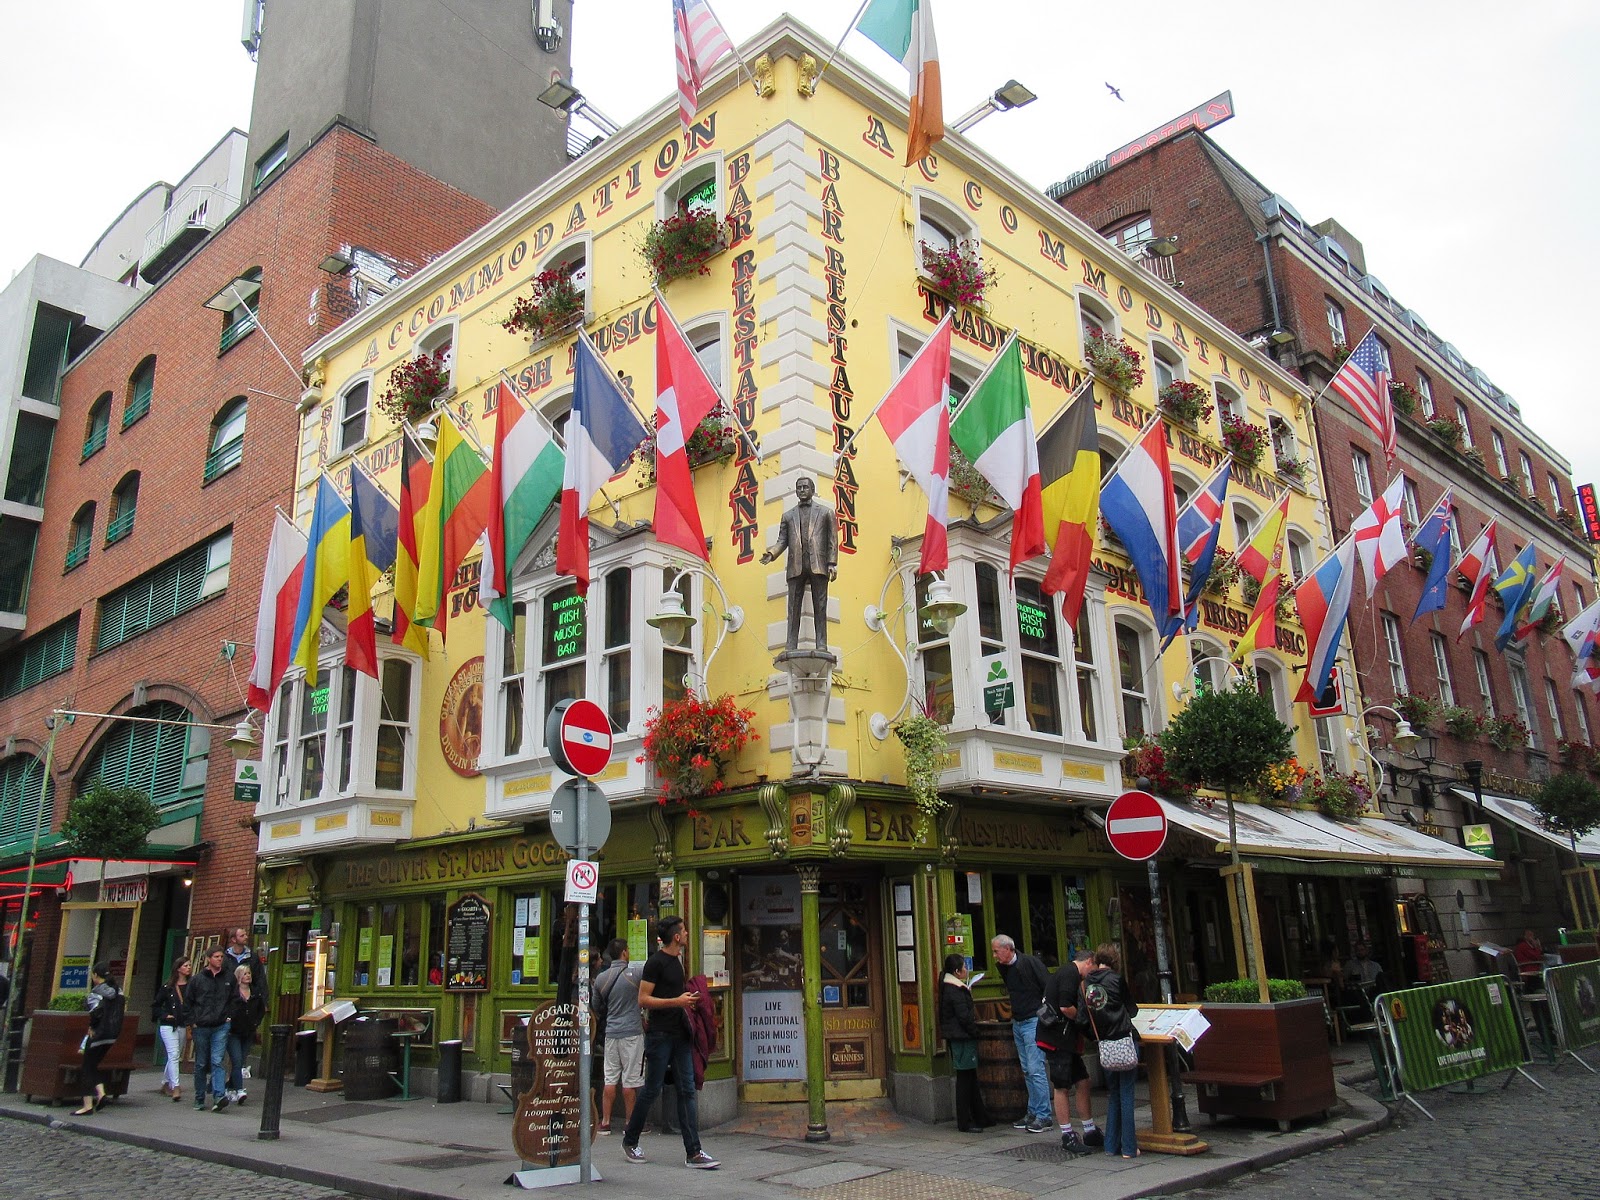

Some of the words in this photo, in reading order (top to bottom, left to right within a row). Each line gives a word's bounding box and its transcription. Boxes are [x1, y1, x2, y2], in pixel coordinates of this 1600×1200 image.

[728, 151, 754, 248] BAR
[818, 147, 845, 245] BAR
[361, 110, 718, 368] ACCOMMODATION
[863, 113, 1273, 406] ACCOMMODATION
[729, 249, 760, 565] RESTAURANT
[824, 244, 860, 555] RESTAURANT
[1176, 429, 1289, 503] RESTURANT
[1582, 486, 1600, 540] HOSTEL
[1019, 611, 1043, 628] IRISH
[553, 623, 582, 642] MUSIC
[1020, 623, 1045, 639] FOOD
[1201, 599, 1249, 638] IRISH
[1274, 625, 1307, 658] USIC
[557, 641, 576, 657] BAR
[864, 803, 917, 843] BAR
[692, 813, 752, 850] BAR
[377, 853, 432, 884] OLIVER
[765, 1001, 782, 1011] LIVE
[551, 1017, 574, 1027] Live
[748, 1016, 800, 1026] TRADITIONAL
[534, 1029, 580, 1037] TRADITION
[750, 1030, 770, 1040] IRISH
[772, 1030, 798, 1040] MUSIC
[535, 1038, 558, 1046] IRISH
[560, 1037, 580, 1046] MUSI
[757, 1044, 791, 1054] PLAYING
[536, 1047, 543, 1055] &
[832, 1053, 864, 1062] GUINNESS
[543, 1059, 577, 1069] Upstairs
[750, 1060, 773, 1069] RIGHT
[776, 1059, 799, 1069] NOW!
[554, 1069, 576, 1079] Floor
[531, 1096, 561, 1107] Ground
[562, 1095, 580, 1105] Floo
[524, 1108, 554, 1118] 1.00pm
[528, 1122, 551, 1132] Come
[552, 1120, 564, 1130] On
